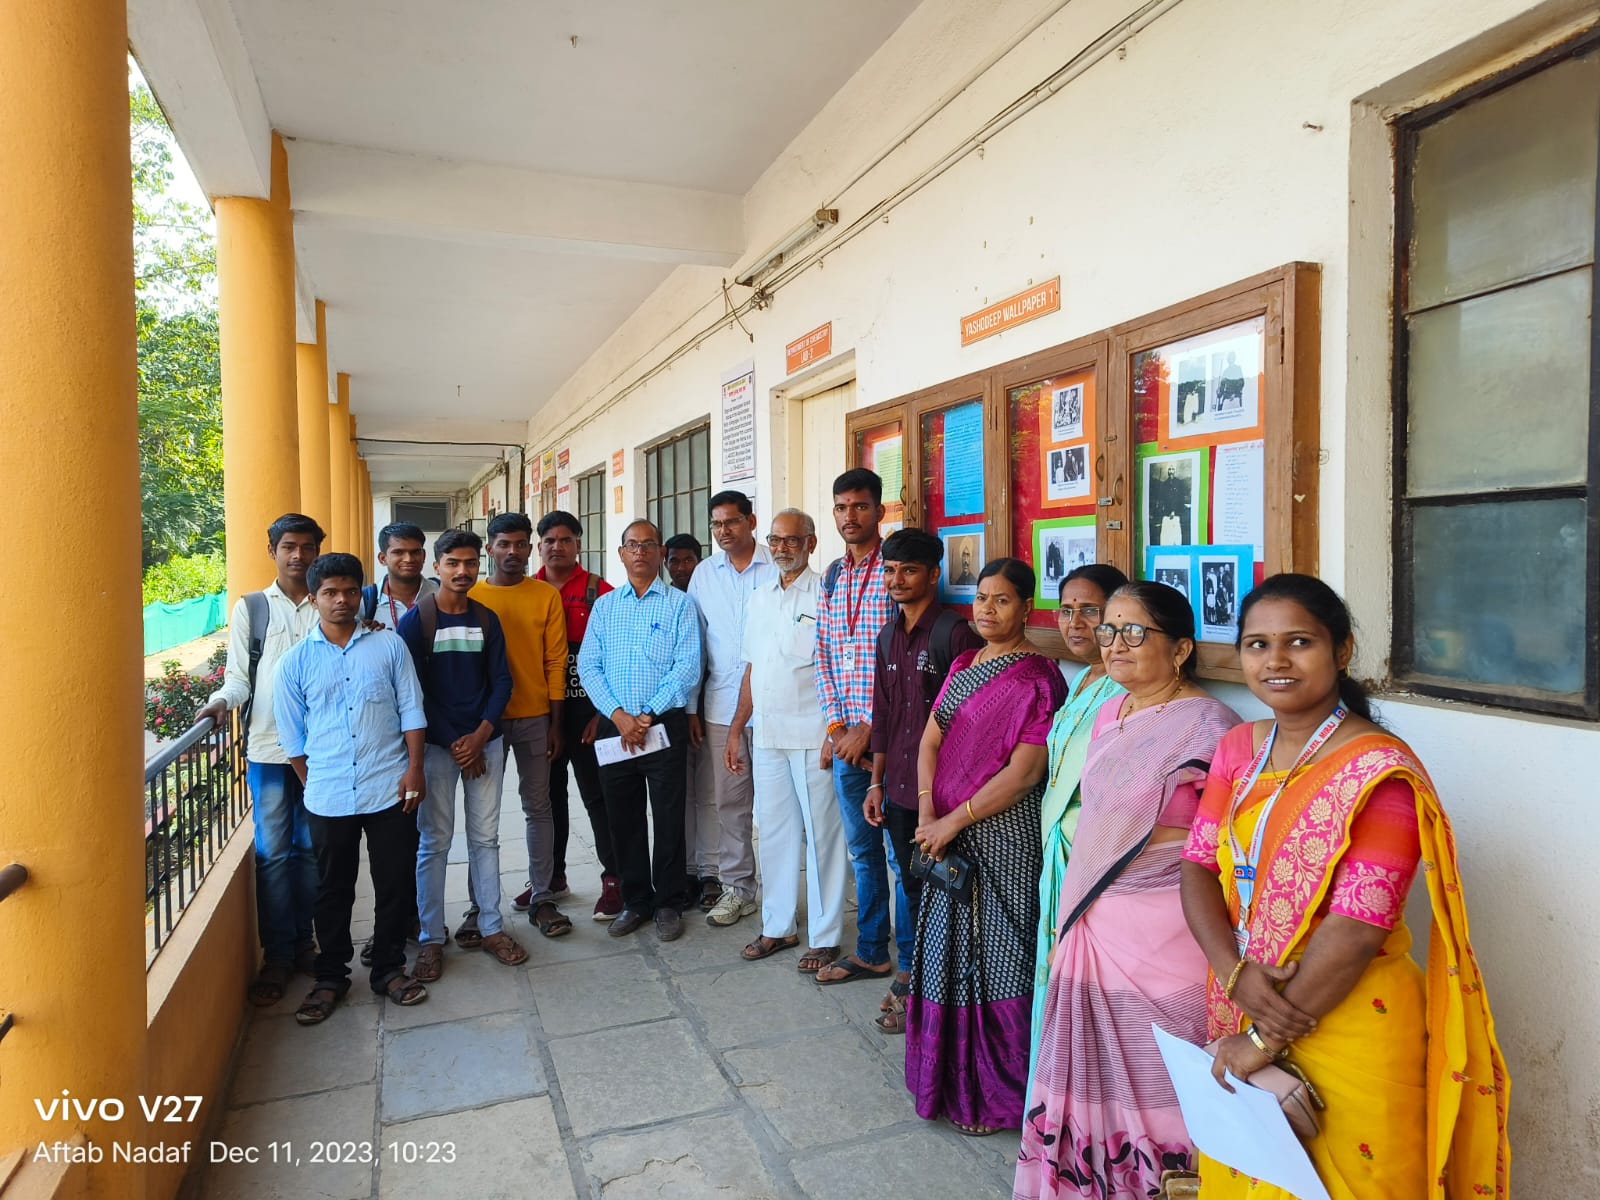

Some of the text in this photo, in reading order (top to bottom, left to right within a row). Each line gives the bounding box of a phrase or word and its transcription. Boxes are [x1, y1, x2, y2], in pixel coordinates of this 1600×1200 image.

[965, 287, 1054, 337] YASHODEEP WALLPAPER 1
